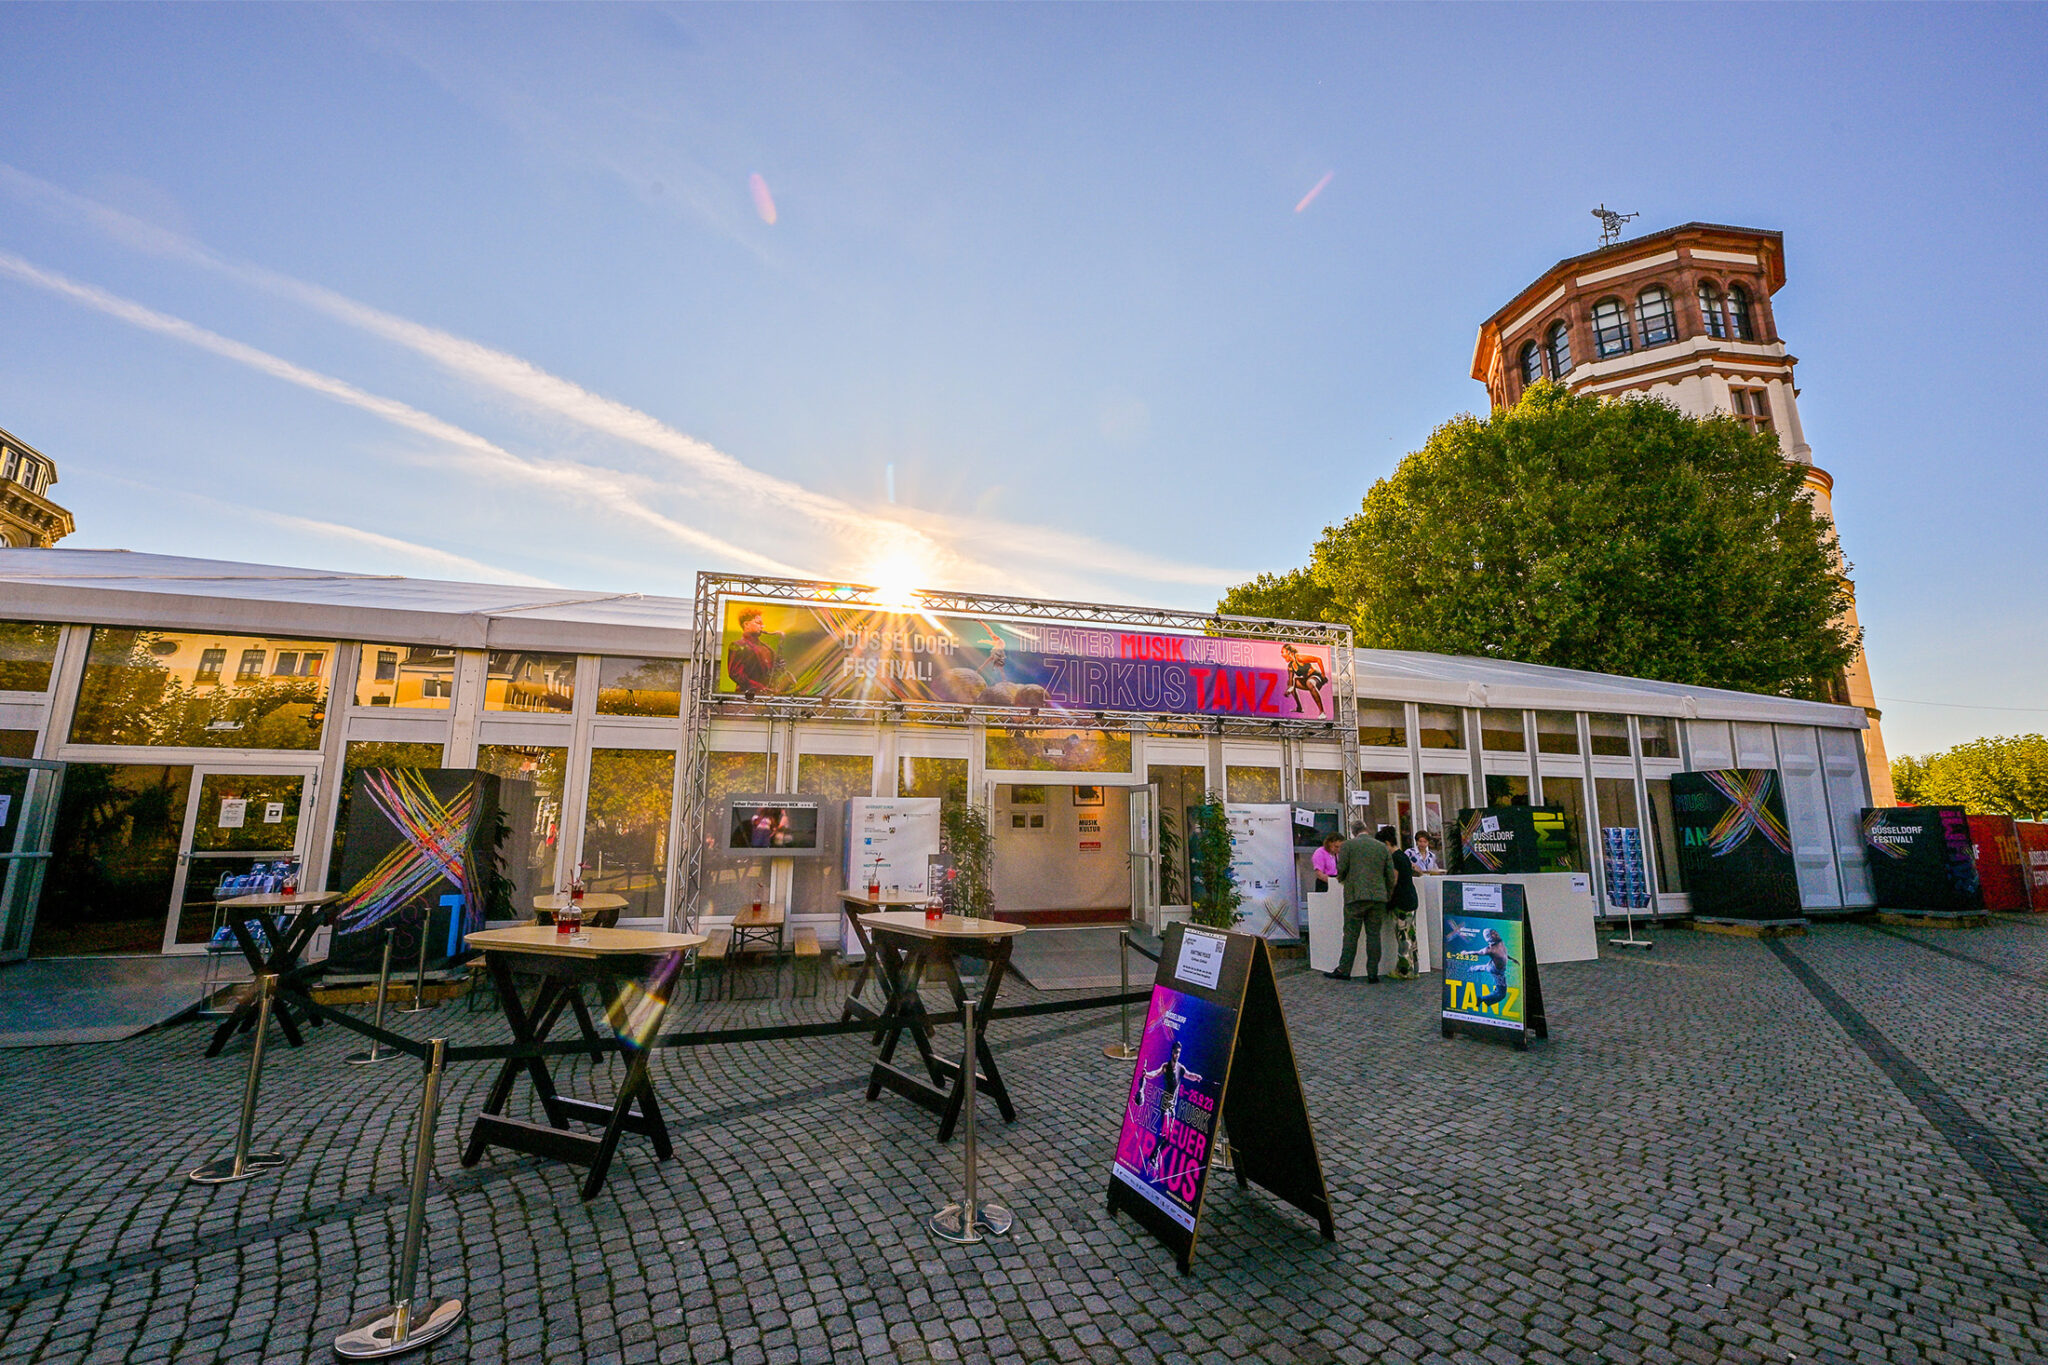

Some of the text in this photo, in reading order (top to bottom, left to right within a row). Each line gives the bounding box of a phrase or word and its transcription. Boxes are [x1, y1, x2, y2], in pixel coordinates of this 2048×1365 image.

[843, 625, 959, 656] DÜSSELDORF
[1016, 625, 1255, 668] THEATER MUSIK NEUER
[843, 657, 933, 681] FESTIVAL!
[1043, 658, 1280, 713] ZIRKUS TANZ
[1871, 825, 1923, 835] DÜSSELDORF
[1873, 835, 1914, 844] FESTIVAL!
[1474, 843, 1506, 852] FESTIVAL!
[1445, 979, 1520, 1018] TANZ
[1177, 1100, 1212, 1134] MUSIK
[1160, 1114, 1207, 1161] NEUER
[1117, 1122, 1200, 1203] ZIRKUS
